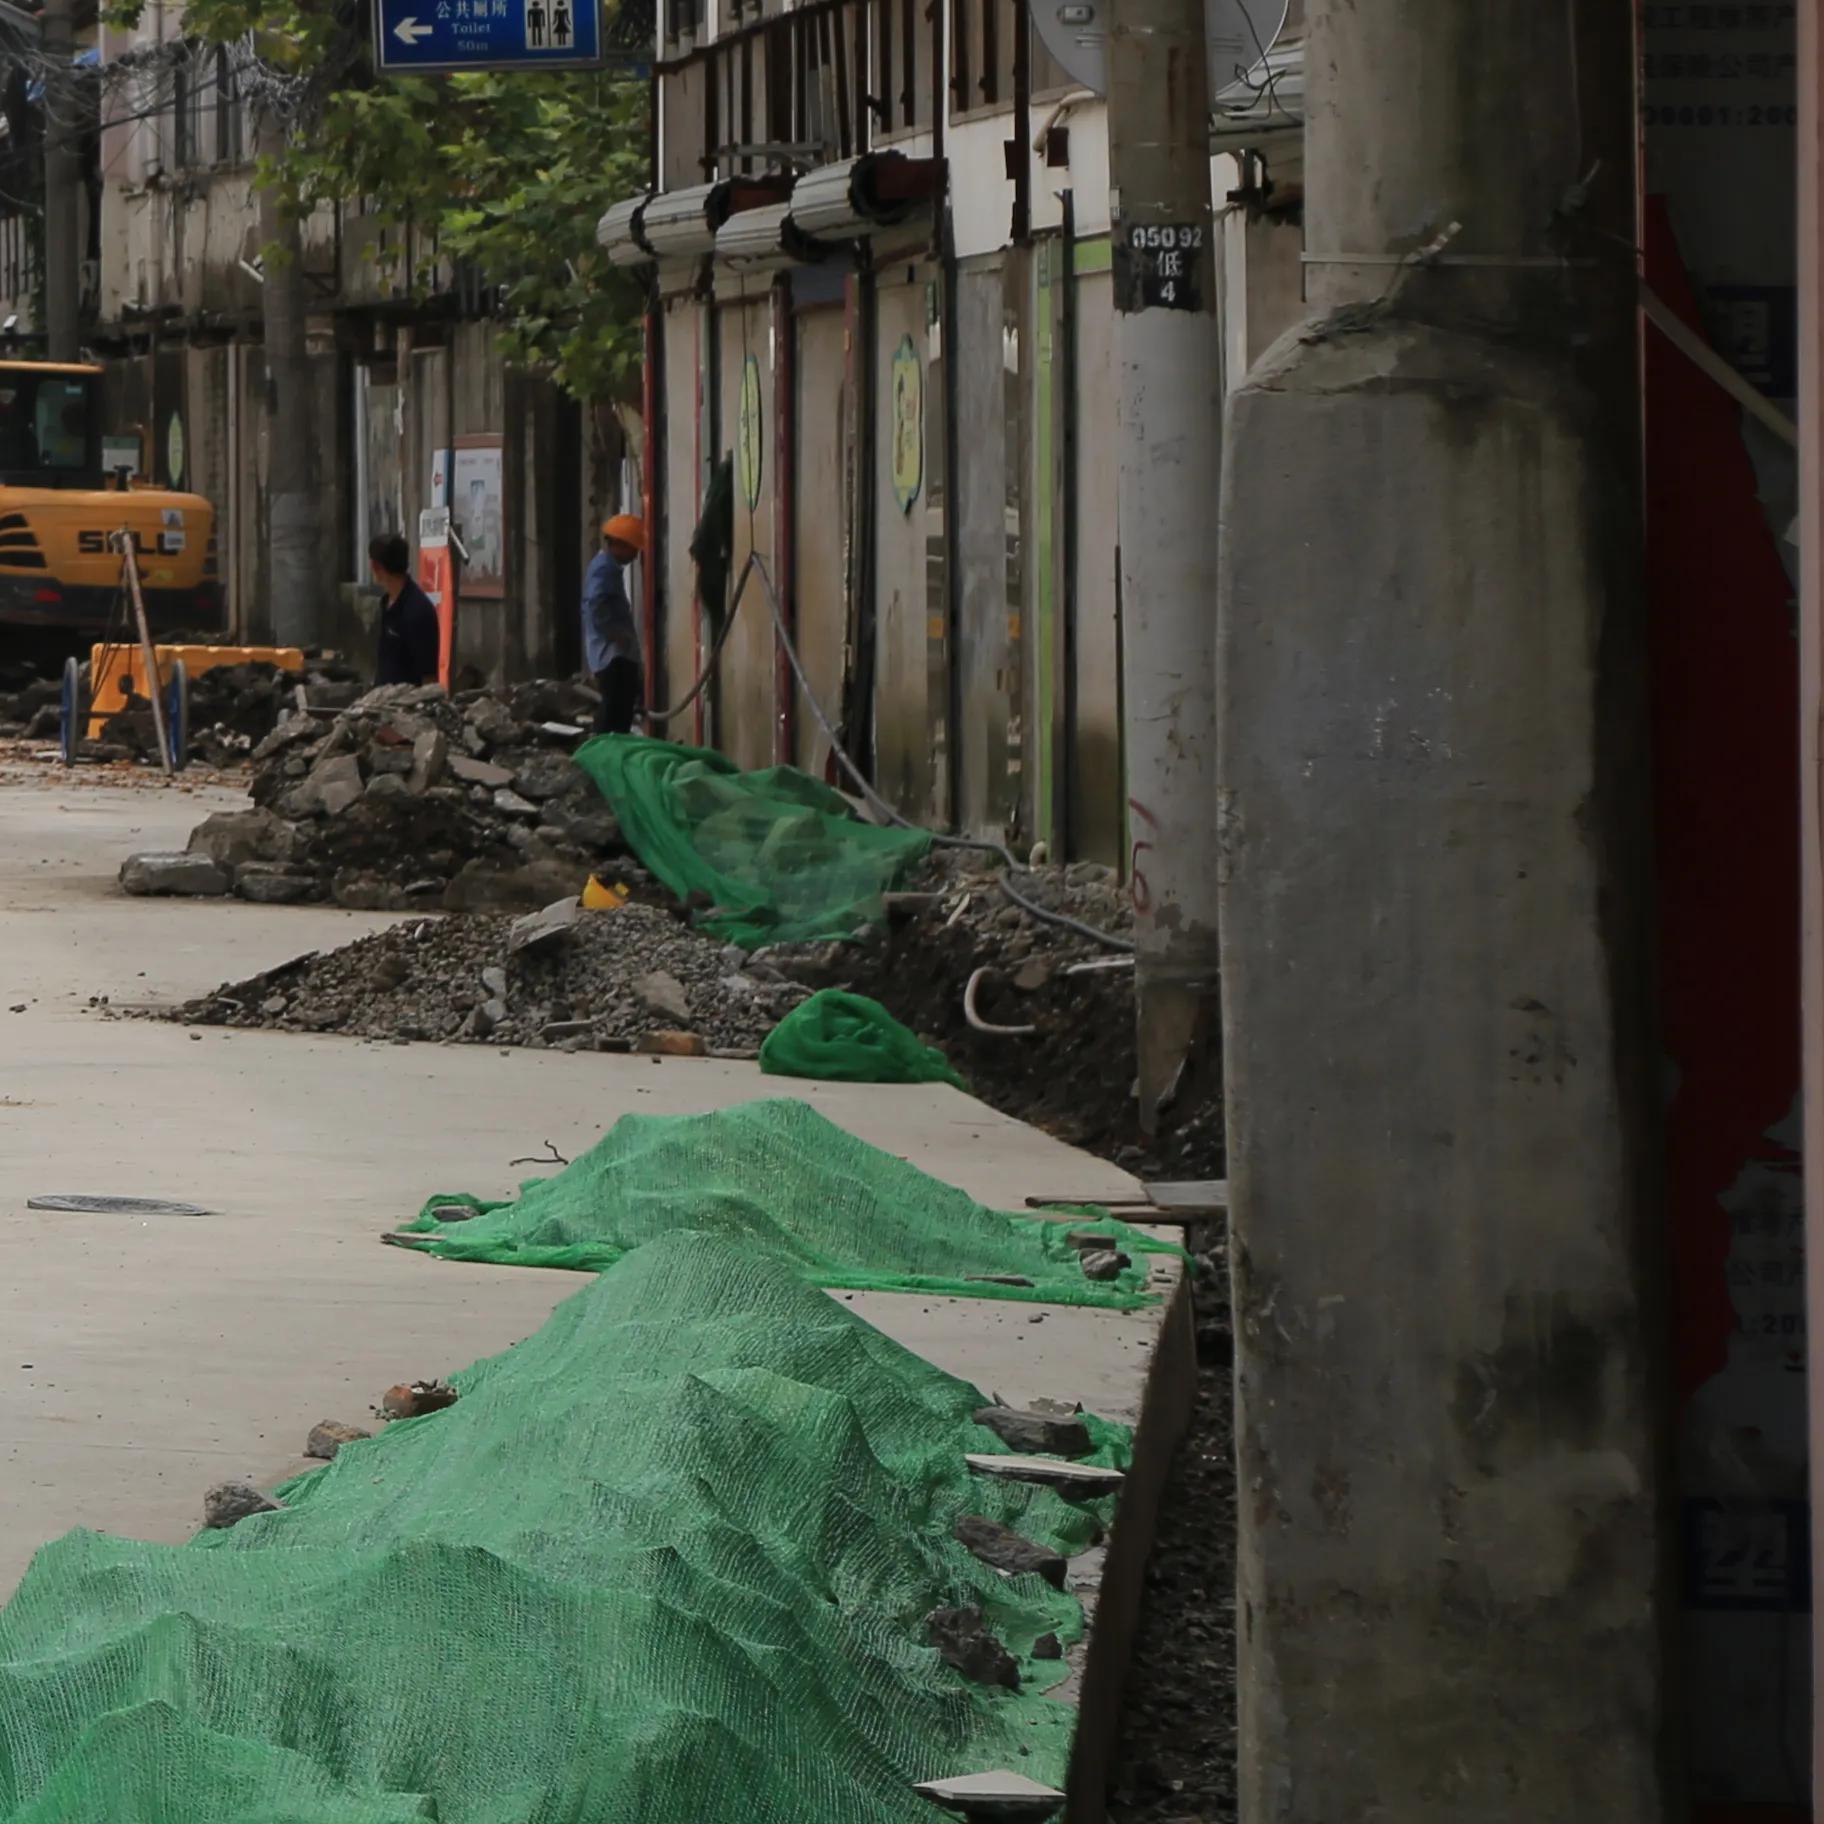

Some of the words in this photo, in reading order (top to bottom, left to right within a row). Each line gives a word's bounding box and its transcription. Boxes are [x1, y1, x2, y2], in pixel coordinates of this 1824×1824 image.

[452, 22, 491, 34] Toilet
[1156, 250, 1183, 277] 低
[1160, 281, 1176, 302] 4
